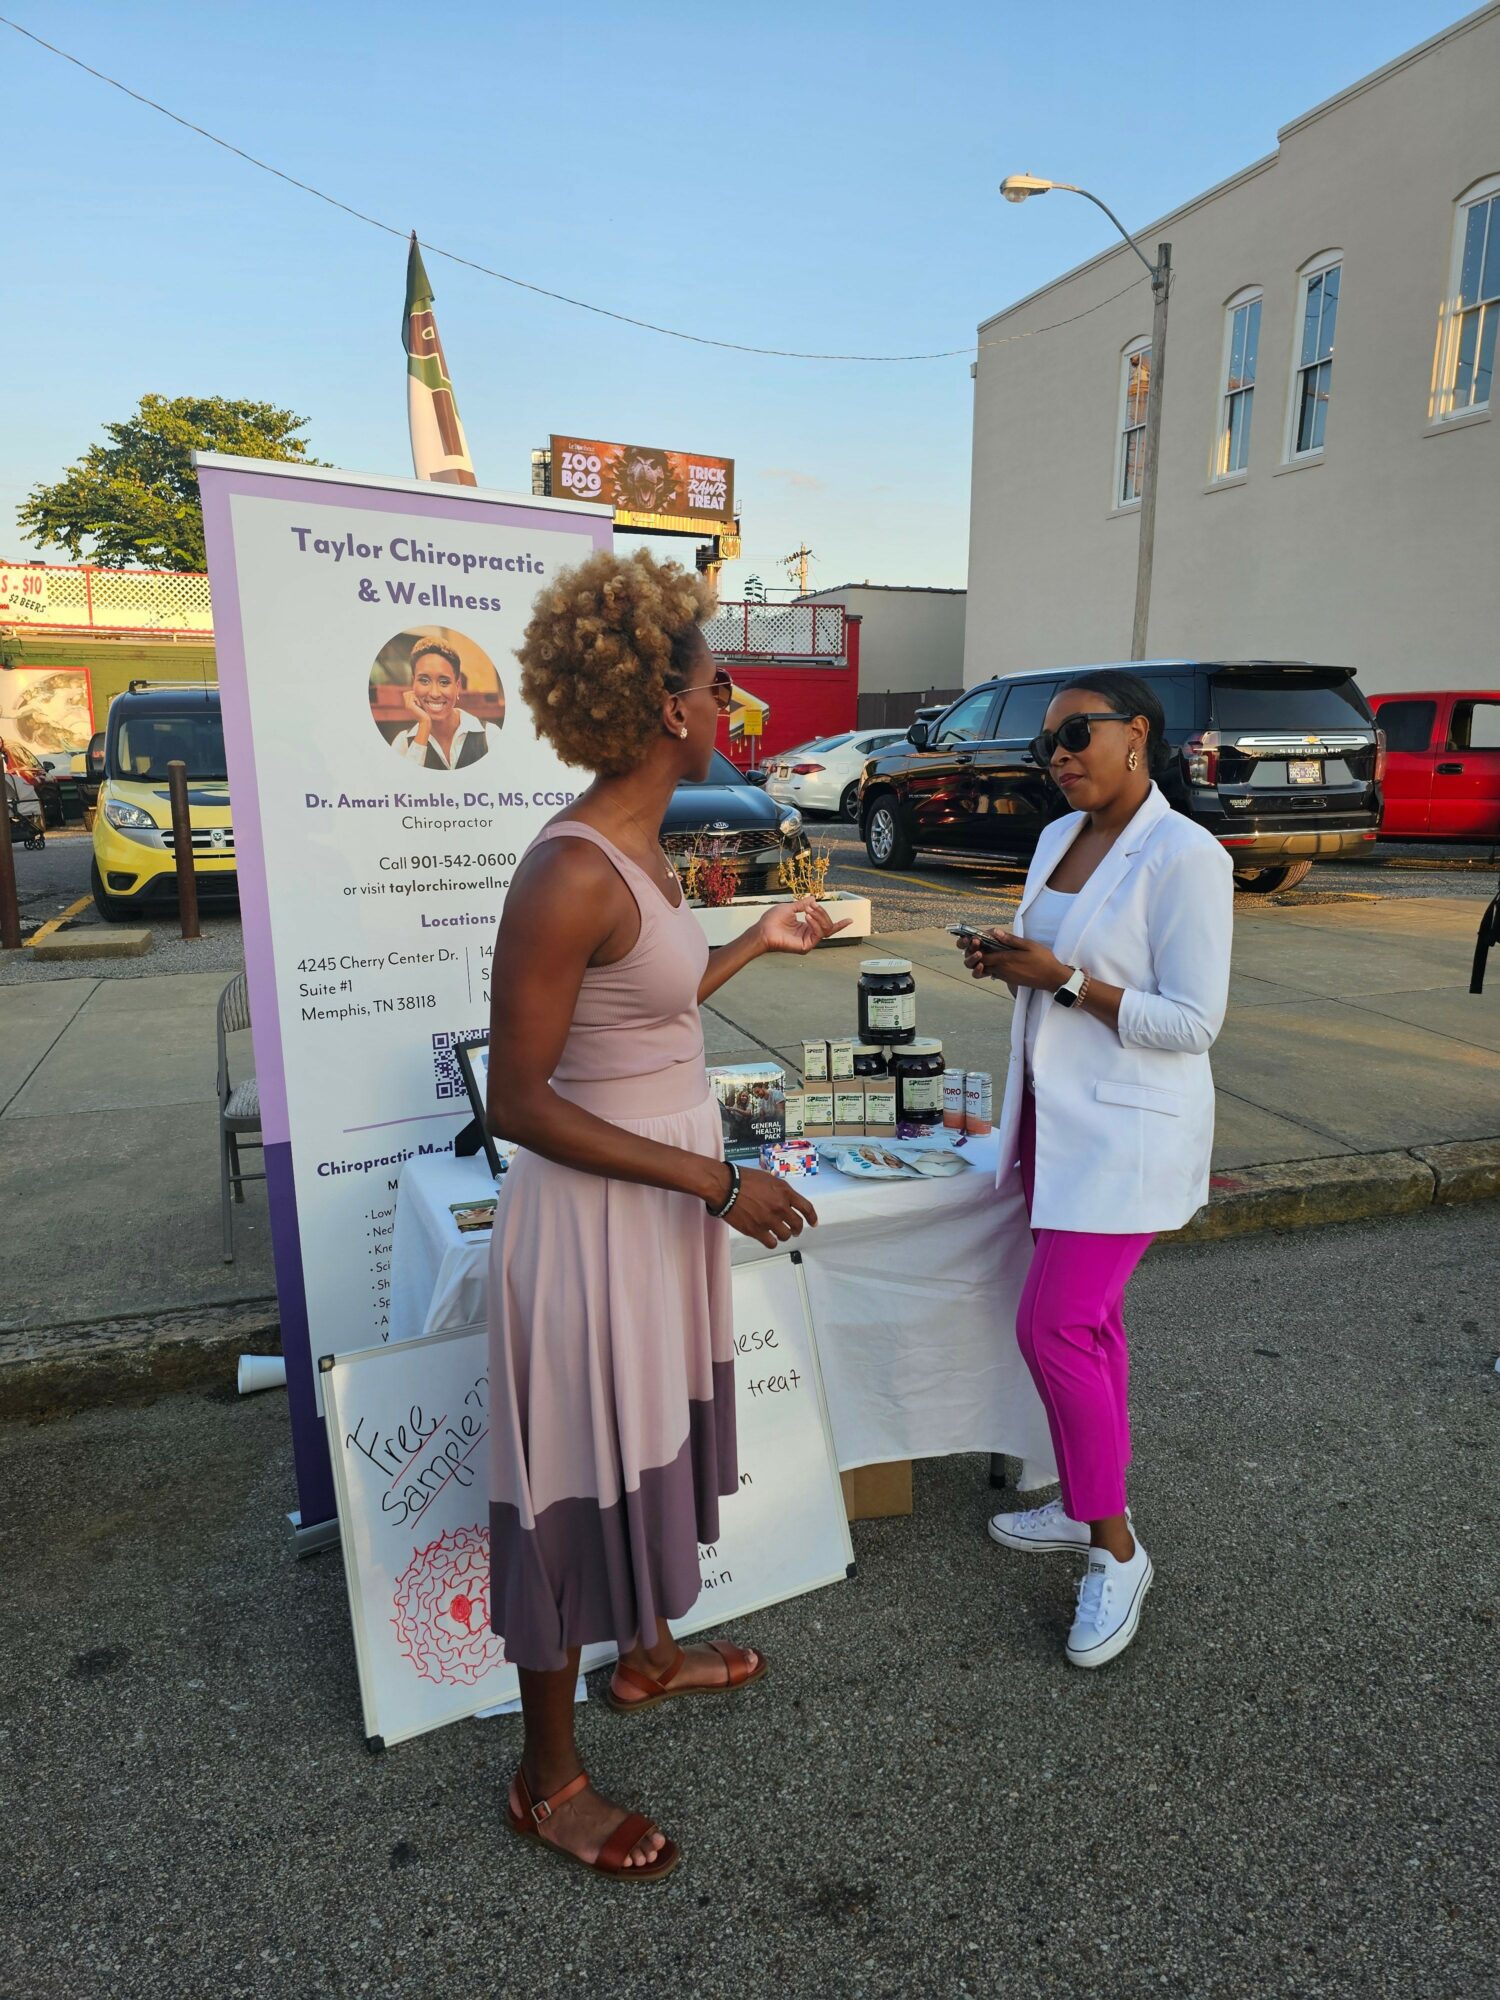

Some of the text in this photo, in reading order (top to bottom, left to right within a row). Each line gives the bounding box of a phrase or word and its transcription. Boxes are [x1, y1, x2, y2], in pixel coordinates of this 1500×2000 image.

[561, 452, 601, 473] ZOO
[561, 470, 601, 490] BOO
[688, 465, 726, 483] TRICK
[687, 479, 727, 498] RAWR
[688, 493, 726, 510] TREAT
[290, 527, 545, 574] Taylor Chiropractic
[22, 575, 42, 596] $10
[358, 578, 501, 612] & Wellness
[20, 597, 47, 613] BEERS
[305, 793, 333, 809] Dr.
[337, 794, 390, 808] Amari
[394, 793, 459, 809] Kimble,
[463, 792, 495, 809] DC,
[498, 792, 529, 808] MS,
[401, 815, 493, 831] Chiropractor
[379, 852, 517, 871] Call 901-542-0600
[343, 886, 357, 896] or
[360, 883, 386, 895] visit
[421, 912, 497, 928] Locations
[297, 948, 459, 973] 4245 Cherry Center Dr.
[299, 979, 353, 997] Suite #1
[301, 994, 437, 1021] Memphis, TN 38118
[751, 1121, 781, 1130] GENERAL
[756, 1127, 781, 1135] HEALTH
[317, 1149, 415, 1177] Chiropractic
[388, 1179, 399, 1191] M
[371, 1209, 392, 1220] Low
[376, 1260, 391, 1272] Sci
[378, 1278, 390, 1290] Sh
[747, 1369, 801, 1397] treat
[346, 1405, 438, 1477] Free
[699, 1545, 718, 1560] in
